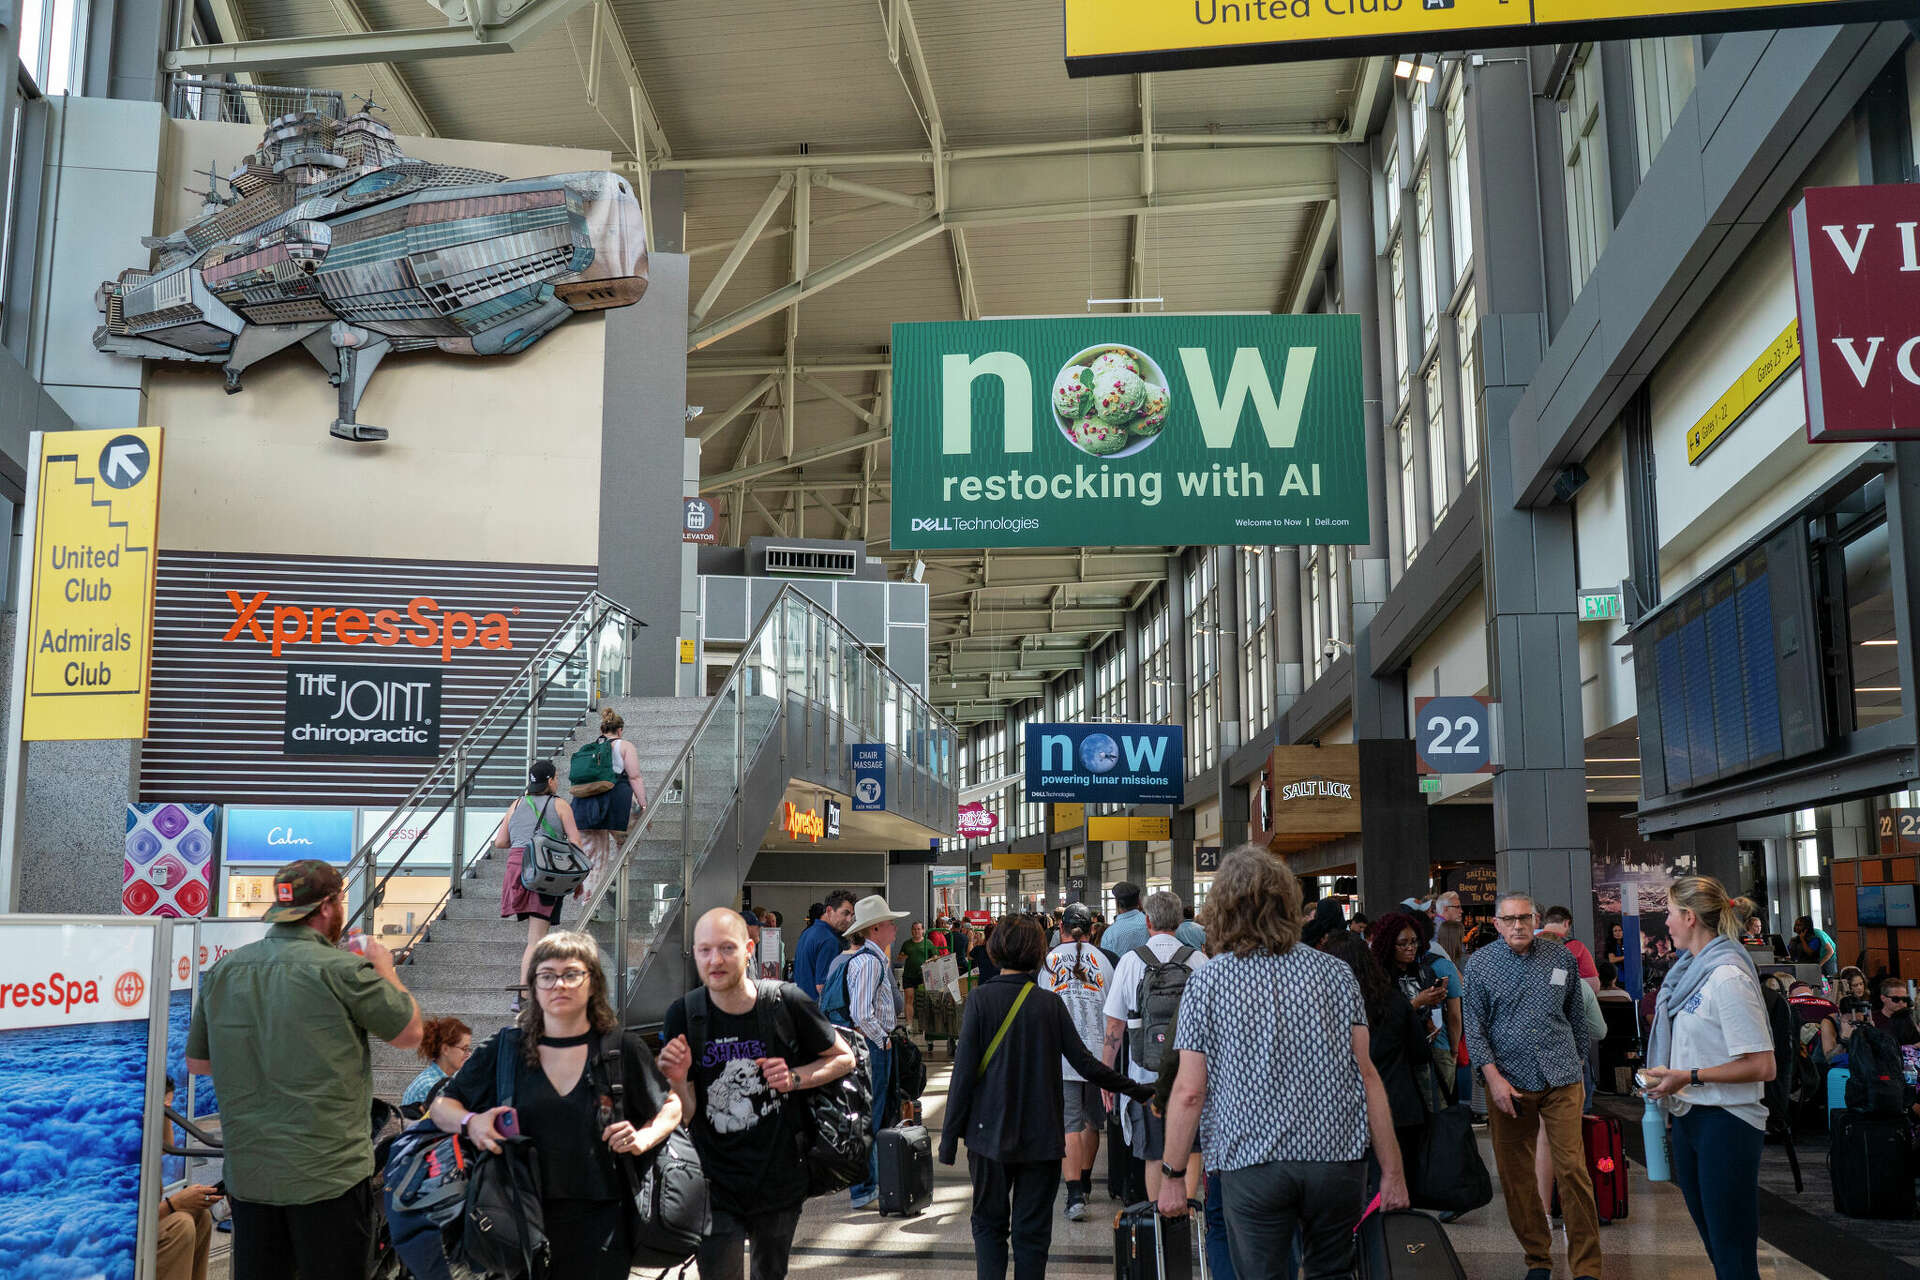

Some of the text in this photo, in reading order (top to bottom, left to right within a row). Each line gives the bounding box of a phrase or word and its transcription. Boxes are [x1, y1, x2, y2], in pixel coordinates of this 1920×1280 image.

[1195, 0, 1310, 25] United
[1757, 361, 1773, 382] Gates
[943, 462, 1321, 506] restocking with AI
[1235, 518, 1272, 526] Welcome
[1274, 518, 1282, 526] to
[1284, 518, 1301, 526] Now
[1314, 517, 1349, 526] Dell.com
[682, 532, 714, 541] LEVATOR
[52, 544, 119, 569] United
[65, 577, 111, 602] Club
[1585, 595, 1617, 618] EXIT
[222, 590, 513, 662] XpresSpa
[40, 627, 131, 653] Admirals
[64, 661, 111, 686] Club
[296, 673, 336, 696] THE
[330, 680, 431, 721] JOINT
[292, 724, 428, 745] chiropractic
[1427, 715, 1480, 754] 22
[853, 760, 883, 769] MASSAGE
[859, 751, 878, 759] CHAIR
[1041, 774, 1168, 786] powering lunar missions
[1282, 780, 1352, 800] SALT LICK
[267, 826, 313, 846] Calm
[388, 826, 430, 841] essie
[1880, 815, 1893, 837] 22
[1201, 853, 1217, 866] 21
[1072, 879, 1083, 888] 20
[1459, 883, 1477, 892] Beer
[1483, 893, 1495, 902] Go
[0, 971, 99, 1014] resSpa
